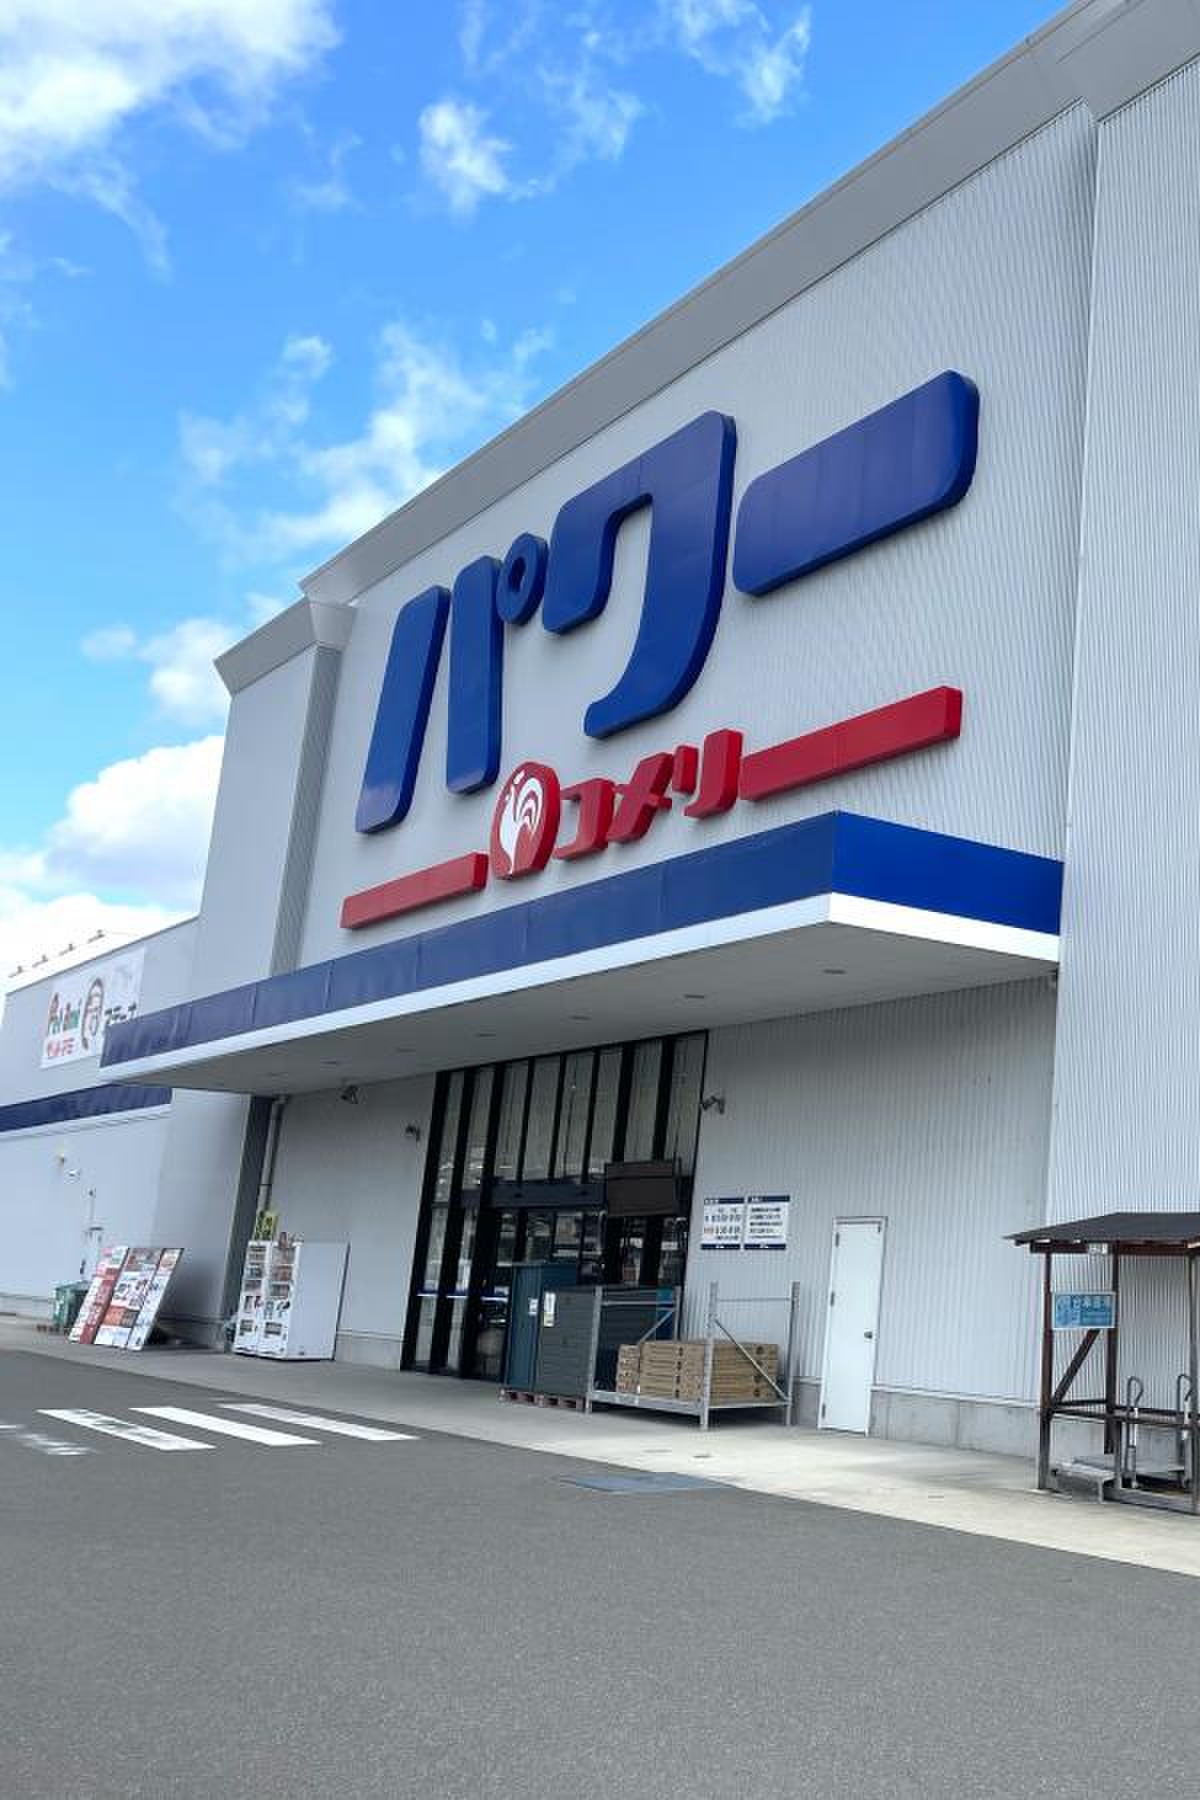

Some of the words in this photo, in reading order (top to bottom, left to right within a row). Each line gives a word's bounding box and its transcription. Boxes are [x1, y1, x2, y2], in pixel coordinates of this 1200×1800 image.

[356, 369, 980, 834] パワー
[552, 728, 743, 860] コメリ
